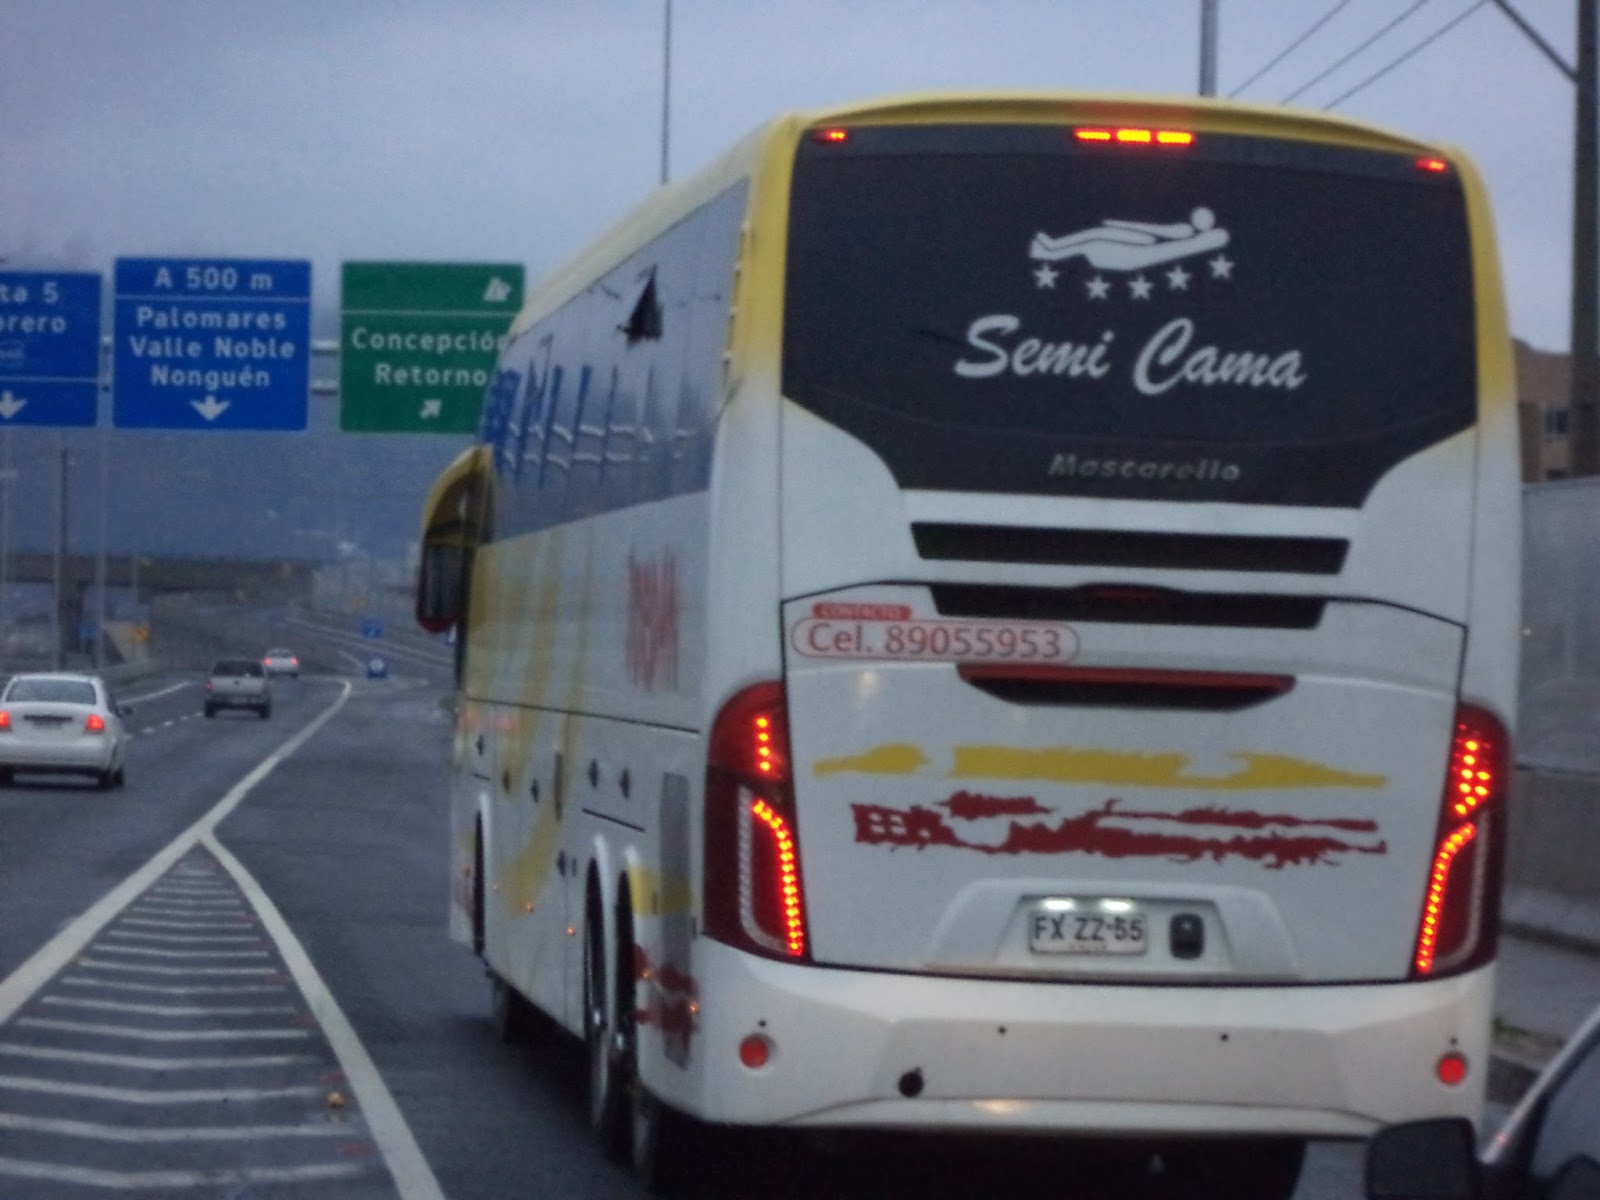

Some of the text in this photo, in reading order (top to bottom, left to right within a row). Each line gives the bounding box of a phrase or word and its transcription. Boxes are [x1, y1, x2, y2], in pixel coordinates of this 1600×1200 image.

[155, 267, 273, 290] A 500 m
[42, 281, 59, 304] 5
[136, 306, 287, 330] Palomares
[130, 336, 296, 360] Valle Noble
[954, 314, 1307, 395] Semi Cama
[151, 365, 271, 391] Nonguén
[375, 362, 488, 387] Retorno
[809, 622, 1060, 660] Cel. 89055953
[1034, 914, 1065, 940] FX
